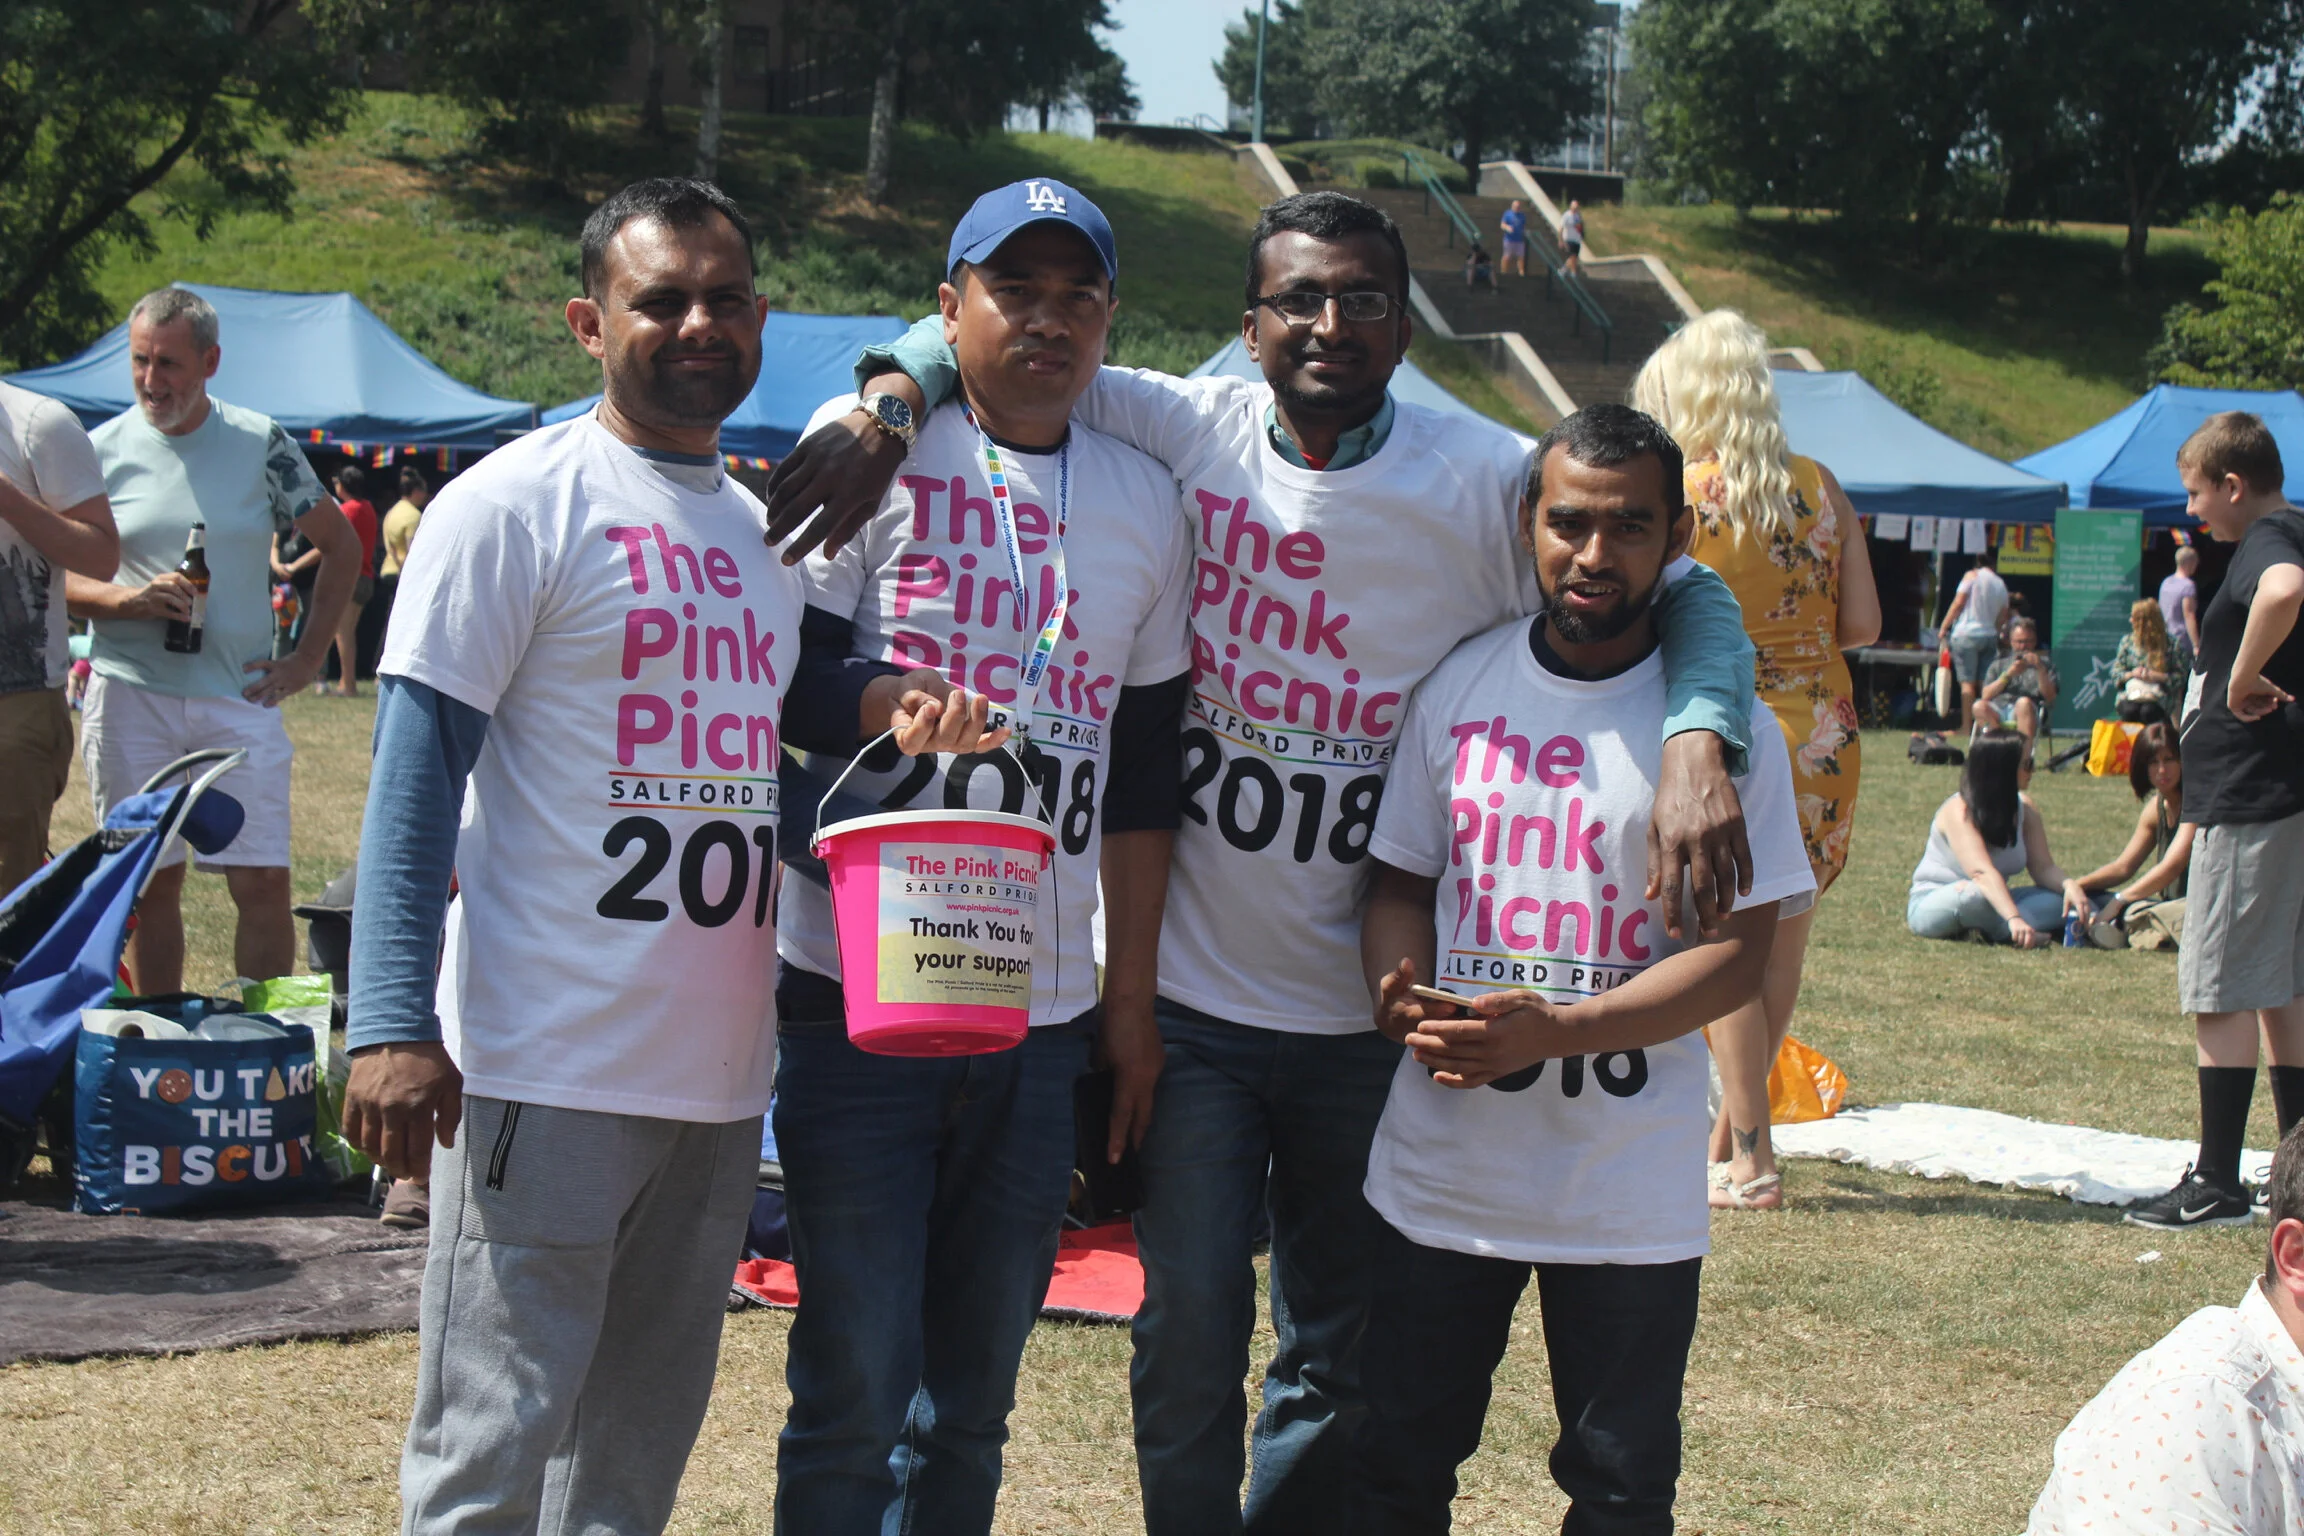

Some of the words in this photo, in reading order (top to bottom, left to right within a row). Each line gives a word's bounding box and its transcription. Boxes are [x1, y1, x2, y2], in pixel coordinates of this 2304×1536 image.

[1025, 181, 1067, 215] LA
[899, 475, 1050, 555] The
[1195, 488, 1326, 580] The
[605, 523, 743, 598] The
[894, 553, 1080, 640] Pink
[621, 602, 777, 687] Pink
[1190, 557, 1350, 660] Pink
[891, 631, 1115, 721] Picnic
[1191, 630, 1402, 737] Picnic
[616, 689, 783, 772] Picni
[1312, 739, 1391, 762] PRIDE
[1450, 715, 1585, 789] The
[610, 778, 754, 805] SALFORD
[1180, 727, 1385, 865] 2018
[906, 855, 946, 875] The
[954, 857, 998, 879] Pink
[1003, 861, 1038, 884] Picnic
[1450, 791, 1606, 875] Pink
[596, 815, 779, 929] 201
[905, 882, 997, 896] SALFORD
[946, 903, 1020, 916] www.pinkpicnic.org.uk
[909, 917, 979, 939] Thank
[985, 920, 1016, 942] You
[1020, 923, 1033, 945] for
[1453, 873, 1652, 962] Picnic
[914, 953, 966, 973] your
[972, 955, 1030, 977] support
[1571, 968, 1633, 989] PRID
[129, 1066, 225, 1104] YOU
[191, 1107, 273, 1137] THE
